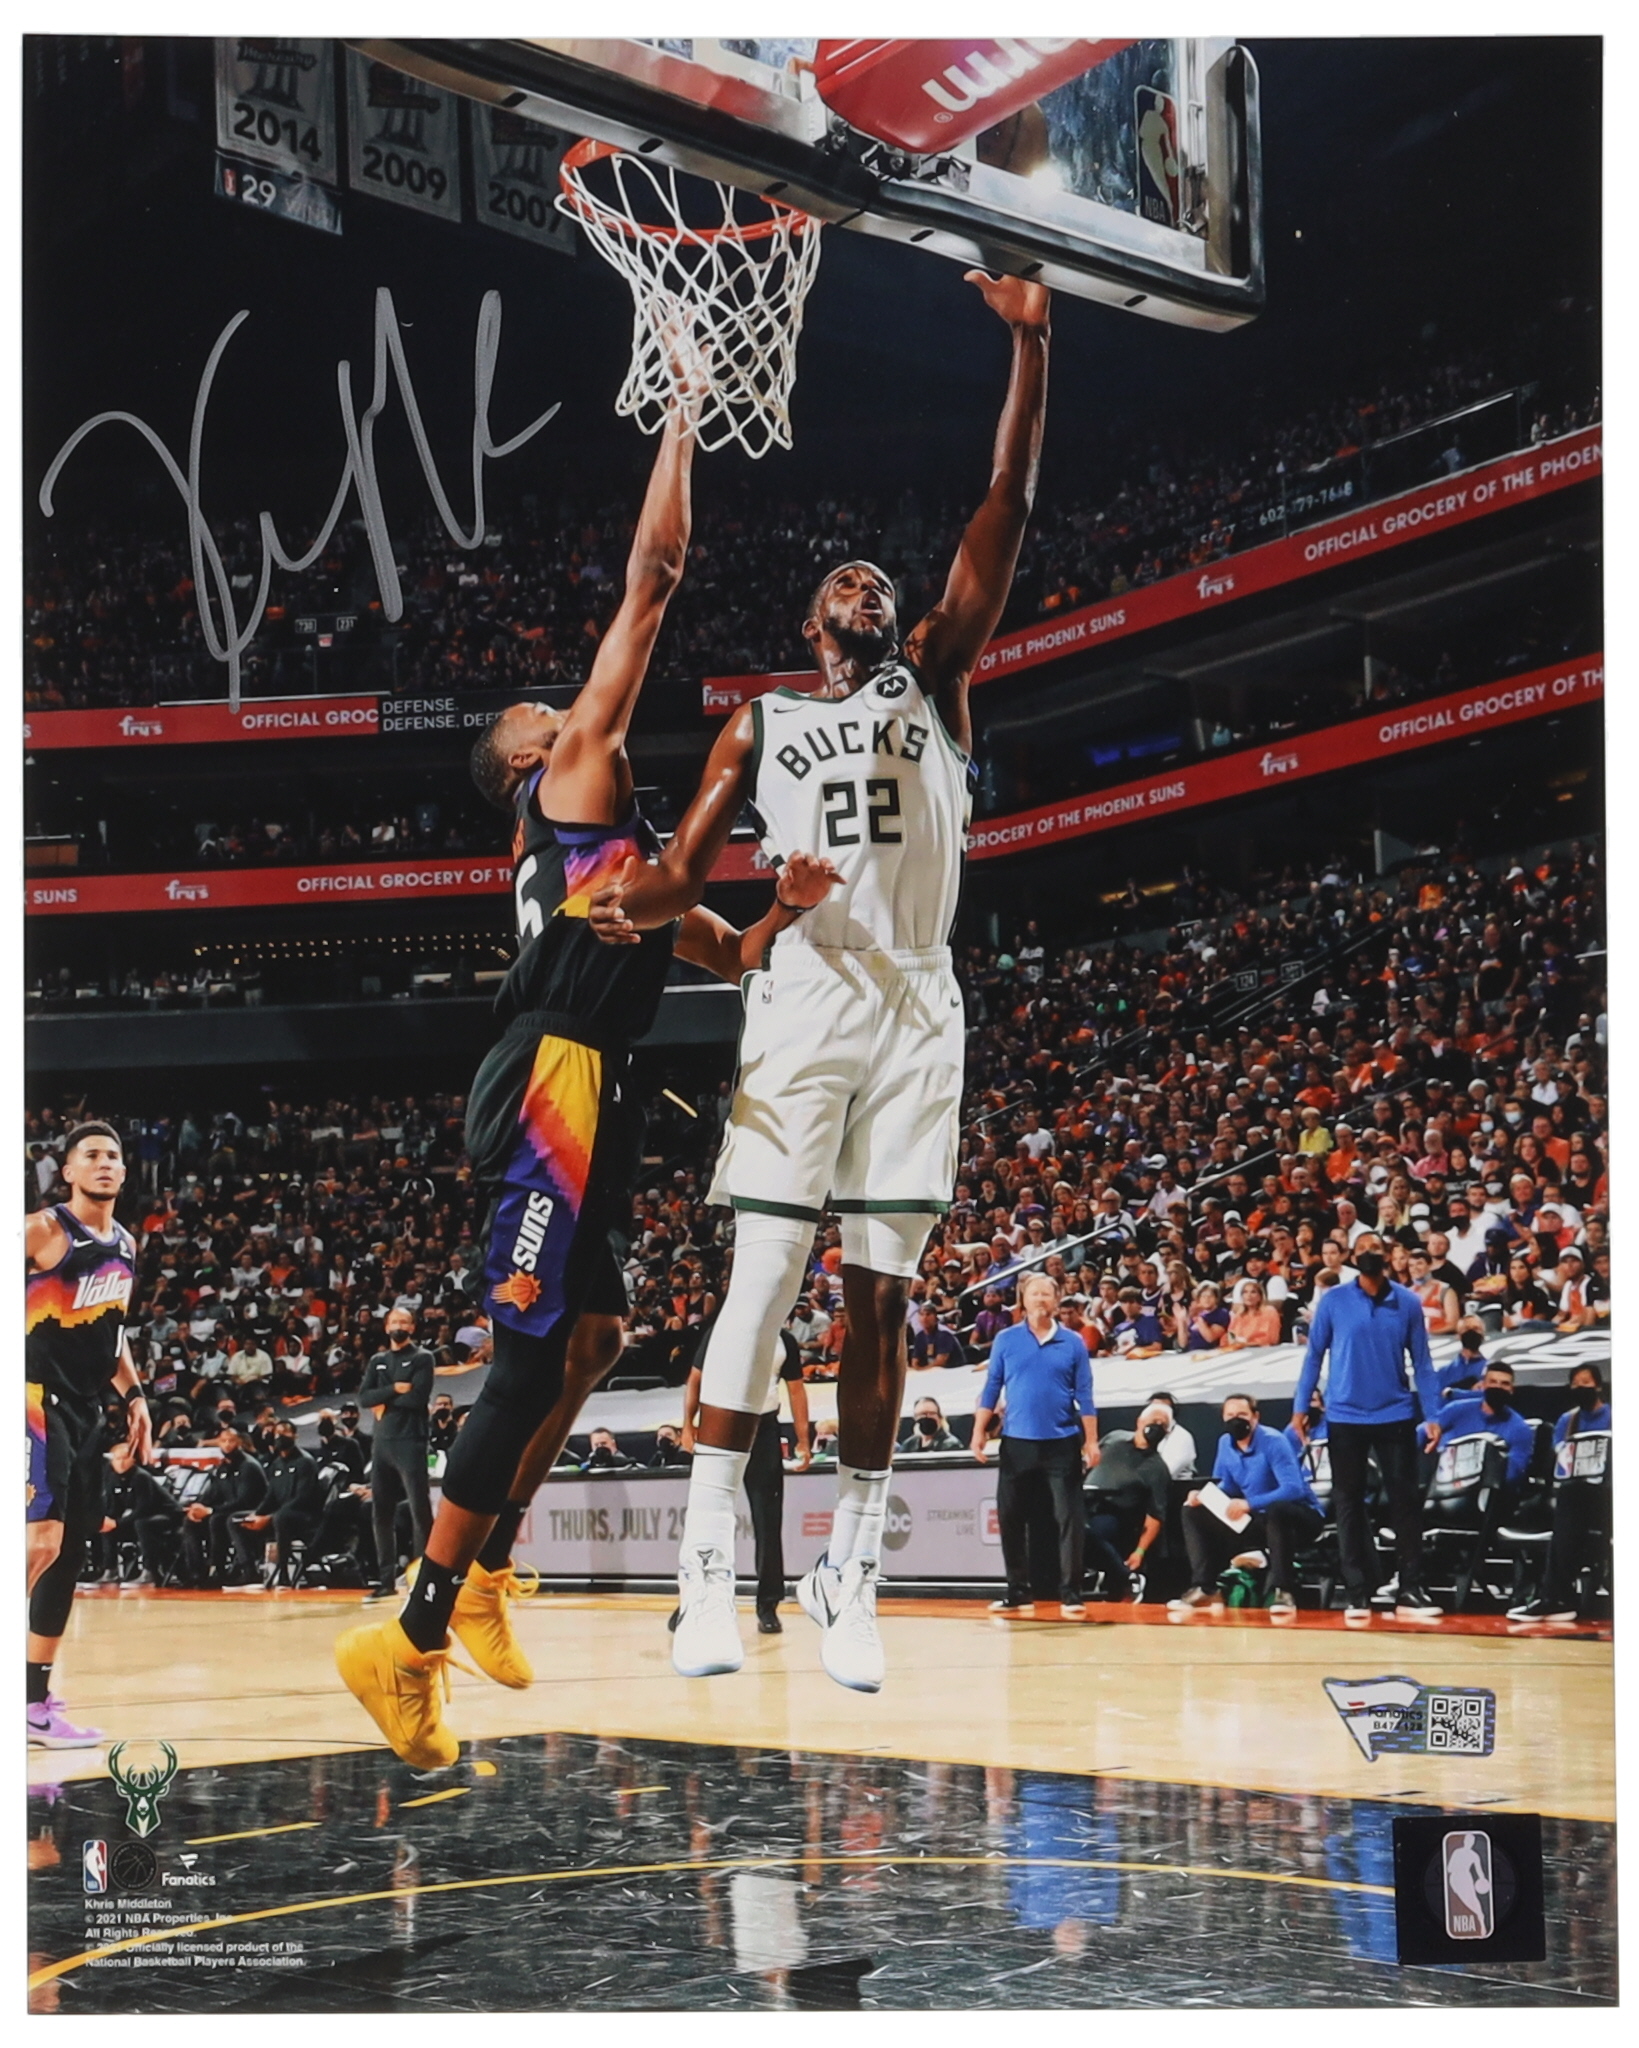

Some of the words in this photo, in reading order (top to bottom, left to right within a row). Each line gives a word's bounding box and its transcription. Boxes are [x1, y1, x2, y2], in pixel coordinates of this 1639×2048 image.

[233, 102, 321, 163] 2014
[363, 147, 447, 200] 2009
[242, 174, 276, 208] 29
[489, 182, 563, 234] 2007
[1304, 523, 1379, 561] OFFICIAL
[1382, 491, 1468, 535] GROCERY
[1473, 480, 1497, 502] OF
[1501, 466, 1535, 493] THE
[1197, 574, 1235, 599] fry's
[980, 649, 997, 671] OF
[1000, 643, 1022, 664] THE
[1026, 623, 1086, 656] PHOENIX
[1090, 609, 1126, 634] SUNS
[702, 685, 742, 706] fry's
[1379, 710, 1455, 743] OFFICIAL
[1459, 683, 1547, 722] GROCERY
[1552, 674, 1576, 697] OF
[119, 715, 163, 736] fry's
[242, 711, 320, 730] OFFICIAL
[325, 709, 379, 726] GROC
[776, 720, 929, 781] BUCKS
[1259, 752, 1299, 776] fry's
[823, 778, 902, 847] 22
[967, 822, 1034, 850] GROCERY
[1037, 816, 1055, 834] OF
[1058, 809, 1081, 829] THE
[1084, 793, 1145, 822] PHOENIX
[1149, 782, 1186, 805] SUNS
[33, 888, 78, 904] SUNS
[165, 879, 209, 900] fry's
[297, 875, 375, 893] OFFICIAL
[379, 870, 464, 888] GROCERY
[469, 868, 493, 884] OF
[511, 1190, 555, 1273] SUNS
[549, 1508, 615, 1542] THURS,
[619, 1507, 662, 1541] JULY
[883, 1507, 912, 1533] bc
[1368, 1705, 1423, 1720] Fanatics
[1453, 1914, 1476, 1932] NBA
